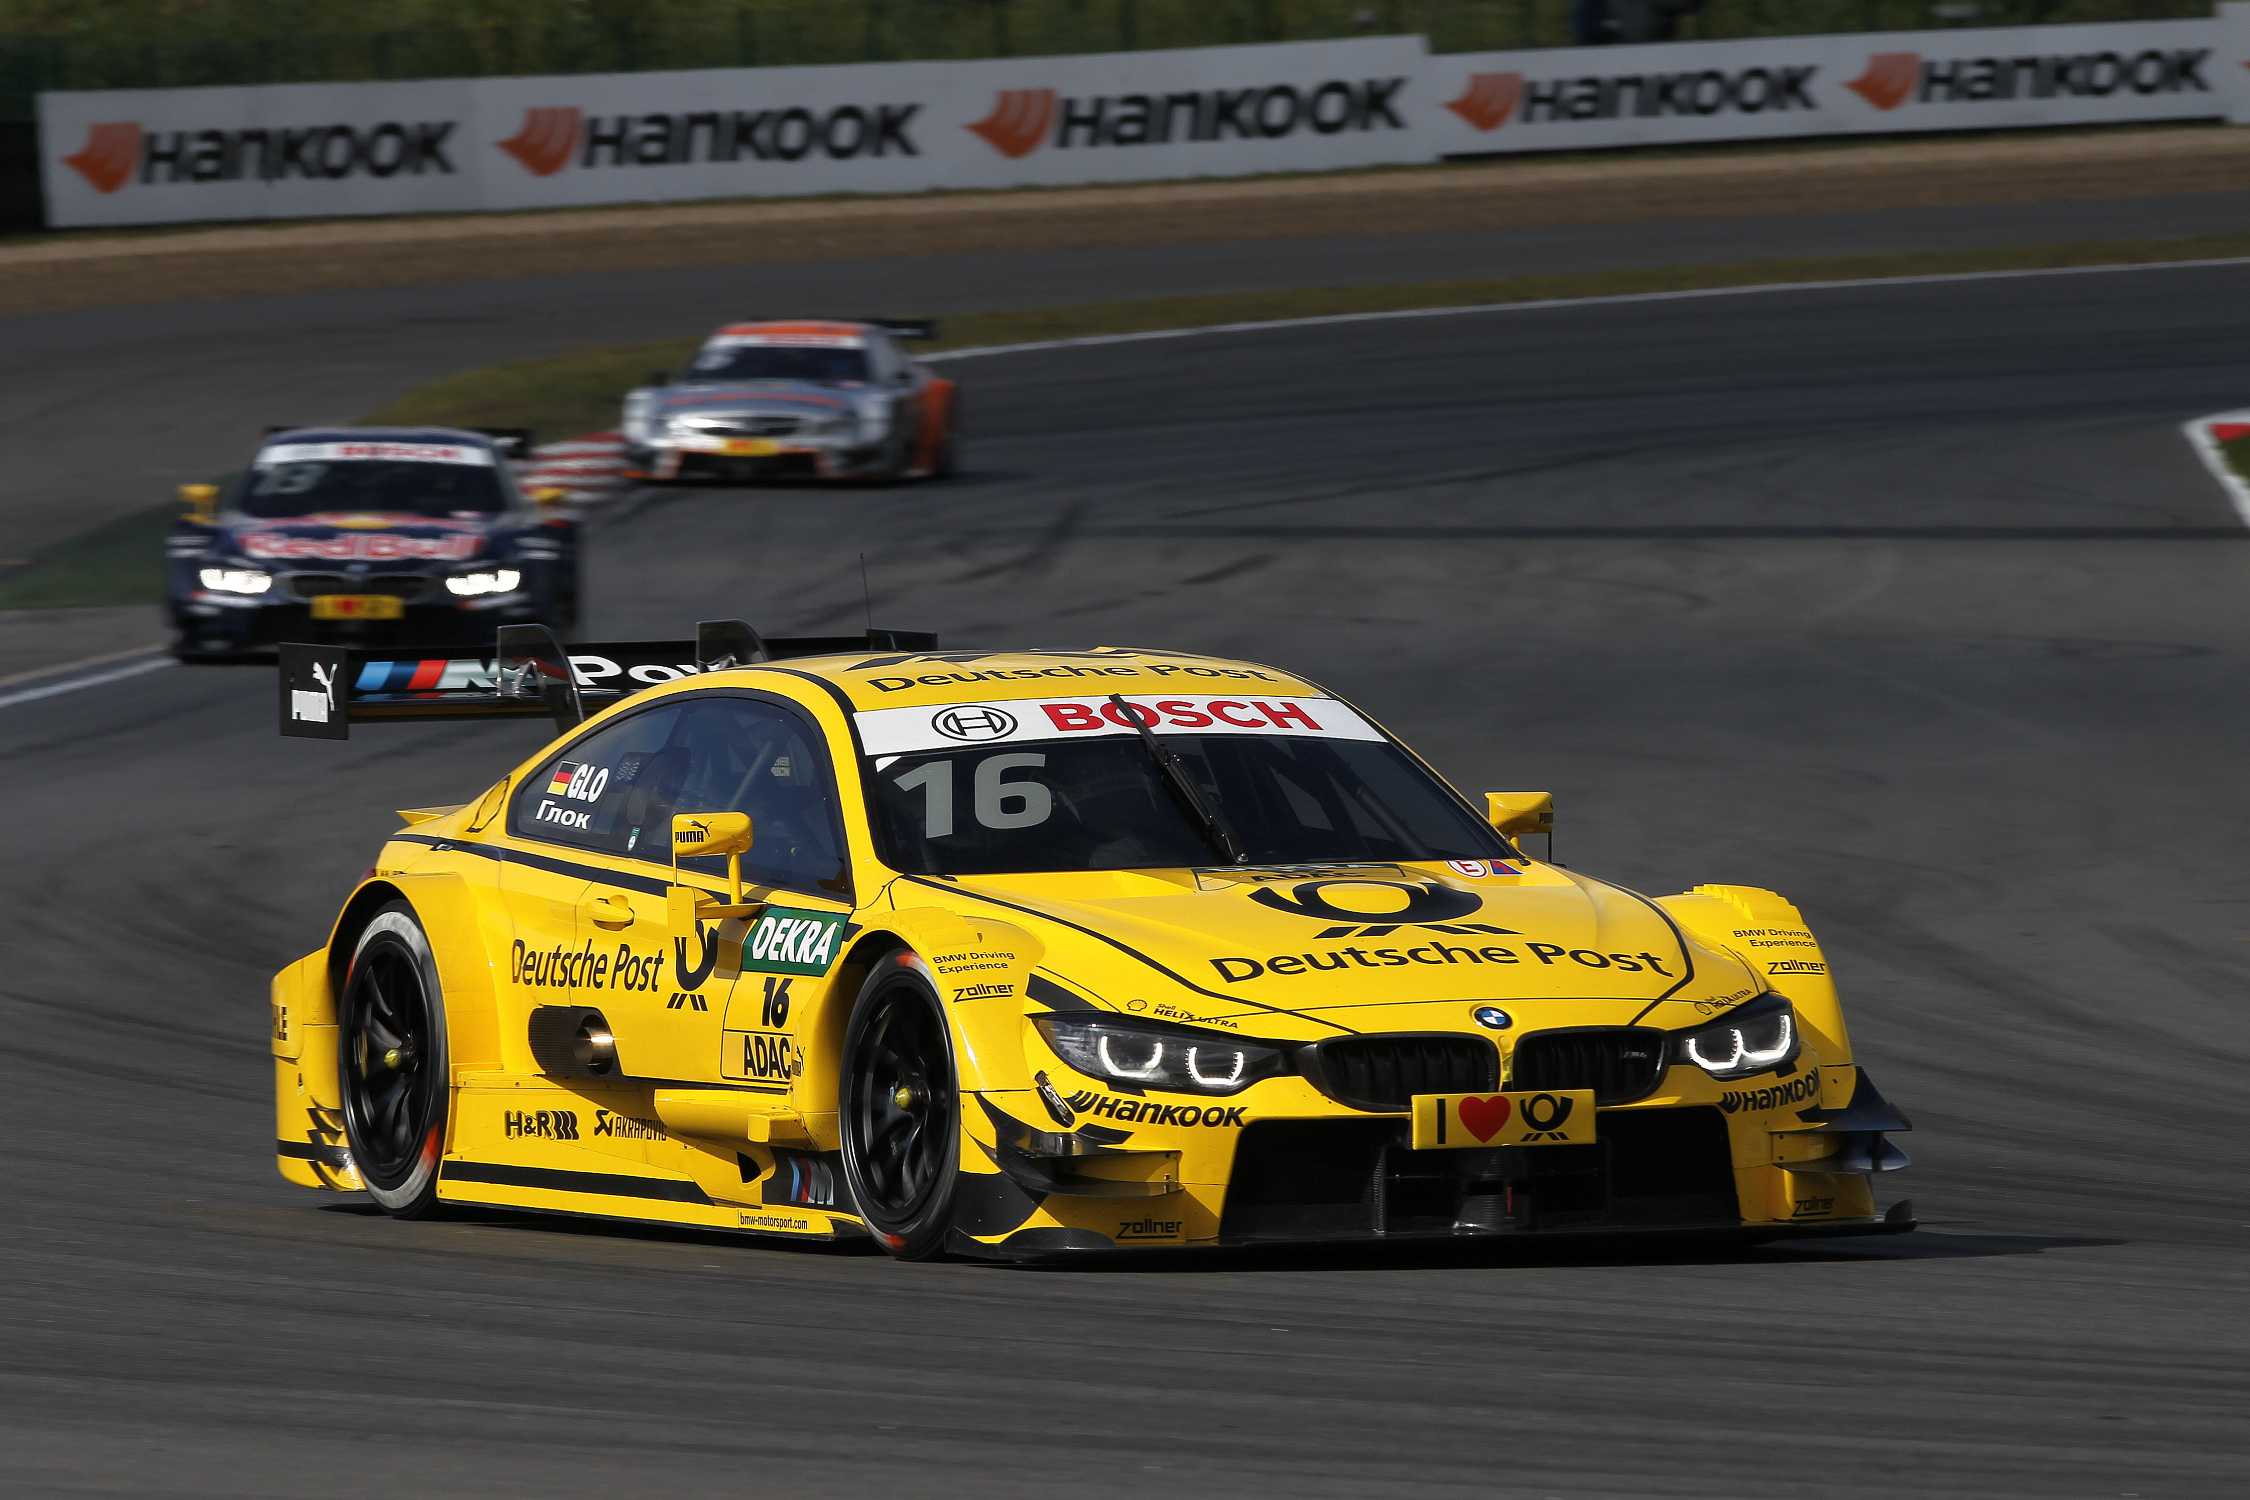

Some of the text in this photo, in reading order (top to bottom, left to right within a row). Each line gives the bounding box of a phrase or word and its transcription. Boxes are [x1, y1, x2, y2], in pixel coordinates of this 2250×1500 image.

[867, 664, 1279, 692] Deutsche Post
[1040, 699, 1324, 732] BOSCH
[567, 763, 609, 802] GLO
[894, 752, 1053, 839] 16
[535, 799, 591, 830] Глок
[674, 830, 704, 843] PUMA
[752, 915, 841, 966] DEKRA
[1732, 928, 1812, 939] BMW Driving
[1749, 939, 1817, 948] Experience
[511, 938, 665, 993] Deutsche Post
[932, 951, 1015, 964] BMW Driving
[938, 962, 1009, 974] Experience
[1209, 941, 1675, 984] Deutsche Post
[761, 976, 792, 1029] 16
[1153, 1008, 1239, 1029] HELIX ULTRA
[743, 1034, 792, 1080] ADAC
[504, 1110, 552, 1138] H&R
[739, 1211, 808, 1231] bmw-motorsport.com
